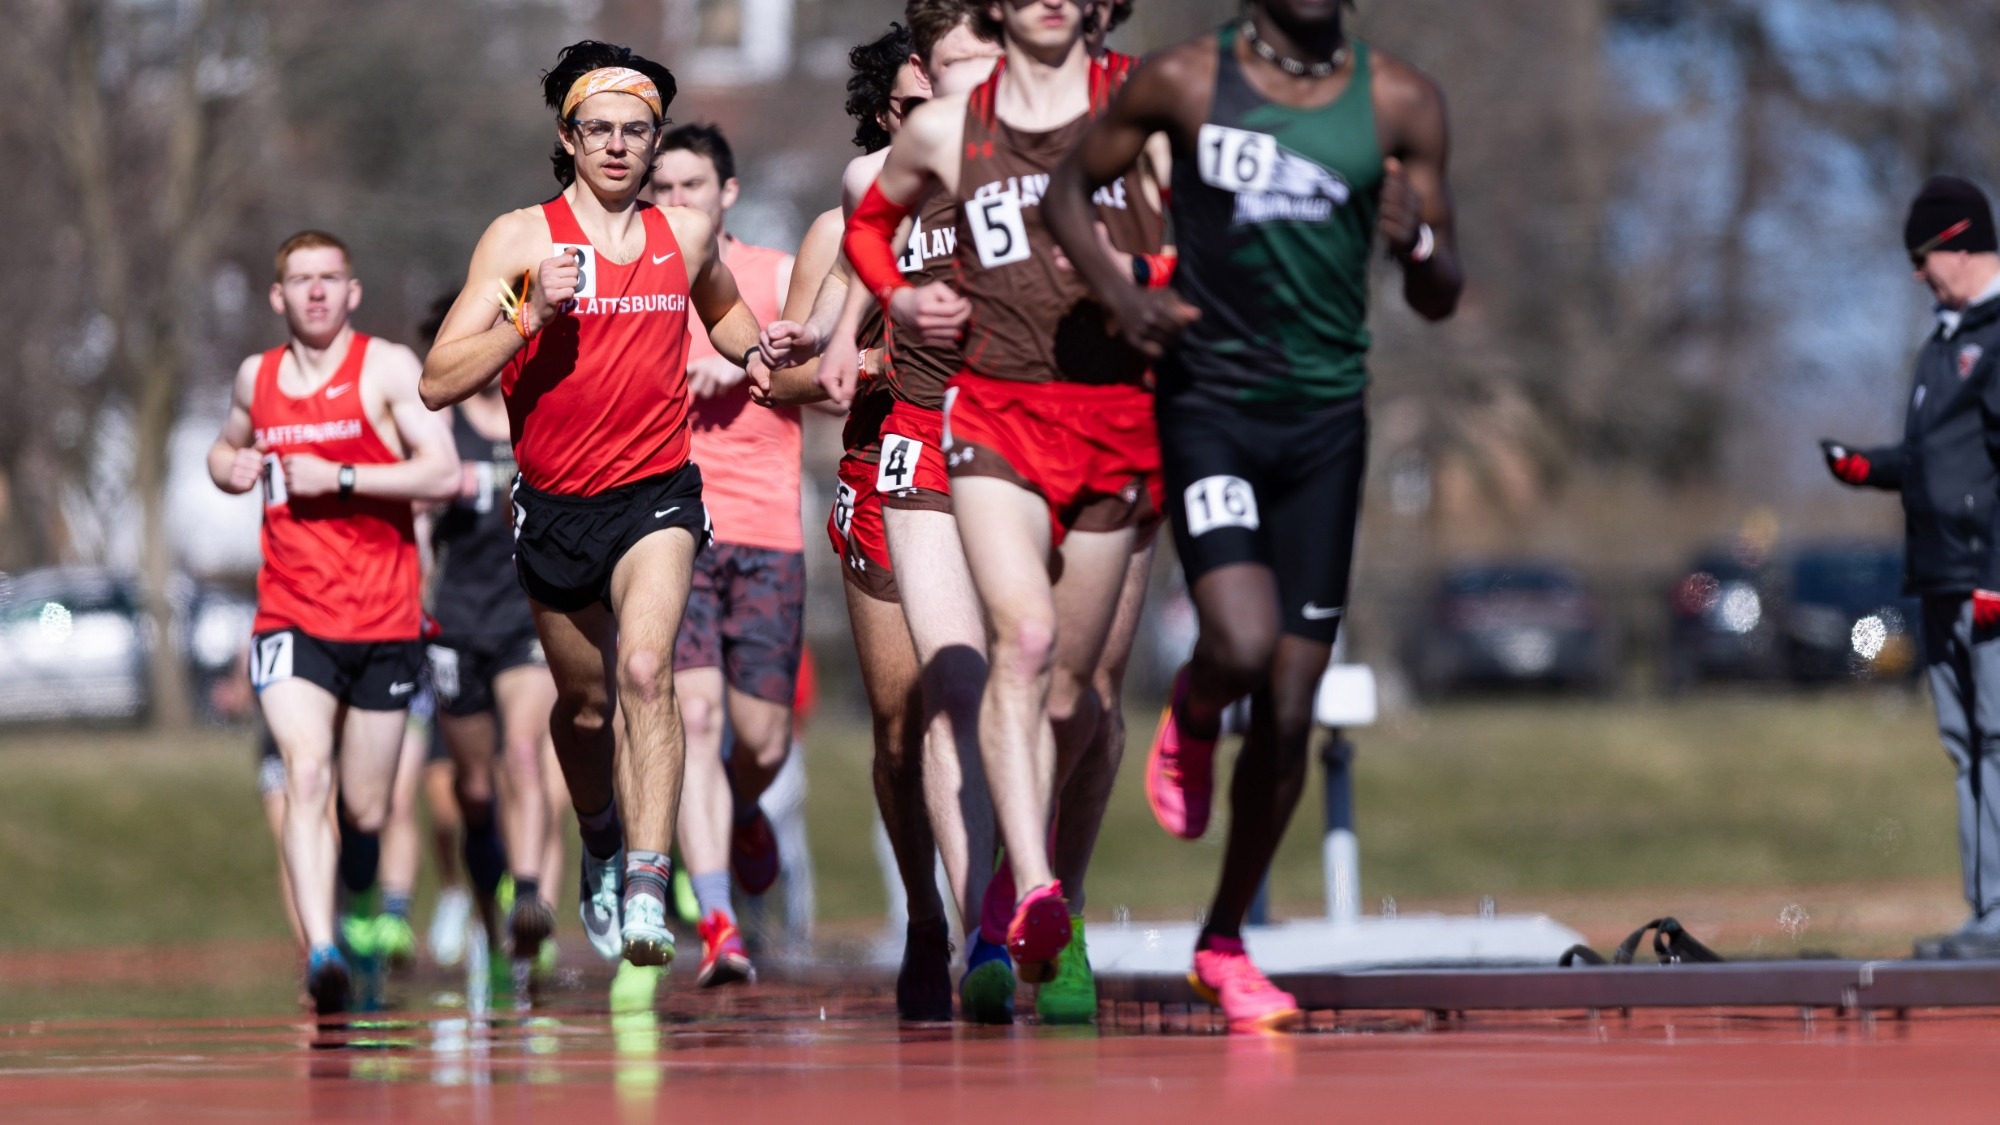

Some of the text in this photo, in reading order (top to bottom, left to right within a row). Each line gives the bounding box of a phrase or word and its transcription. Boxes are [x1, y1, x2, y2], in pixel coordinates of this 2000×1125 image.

[1211, 136, 1261, 182] 16
[983, 200, 1012, 258] 5
[884, 439, 910, 486] 4
[1197, 480, 1247, 520] 16
[256, 638, 283, 675] 17
